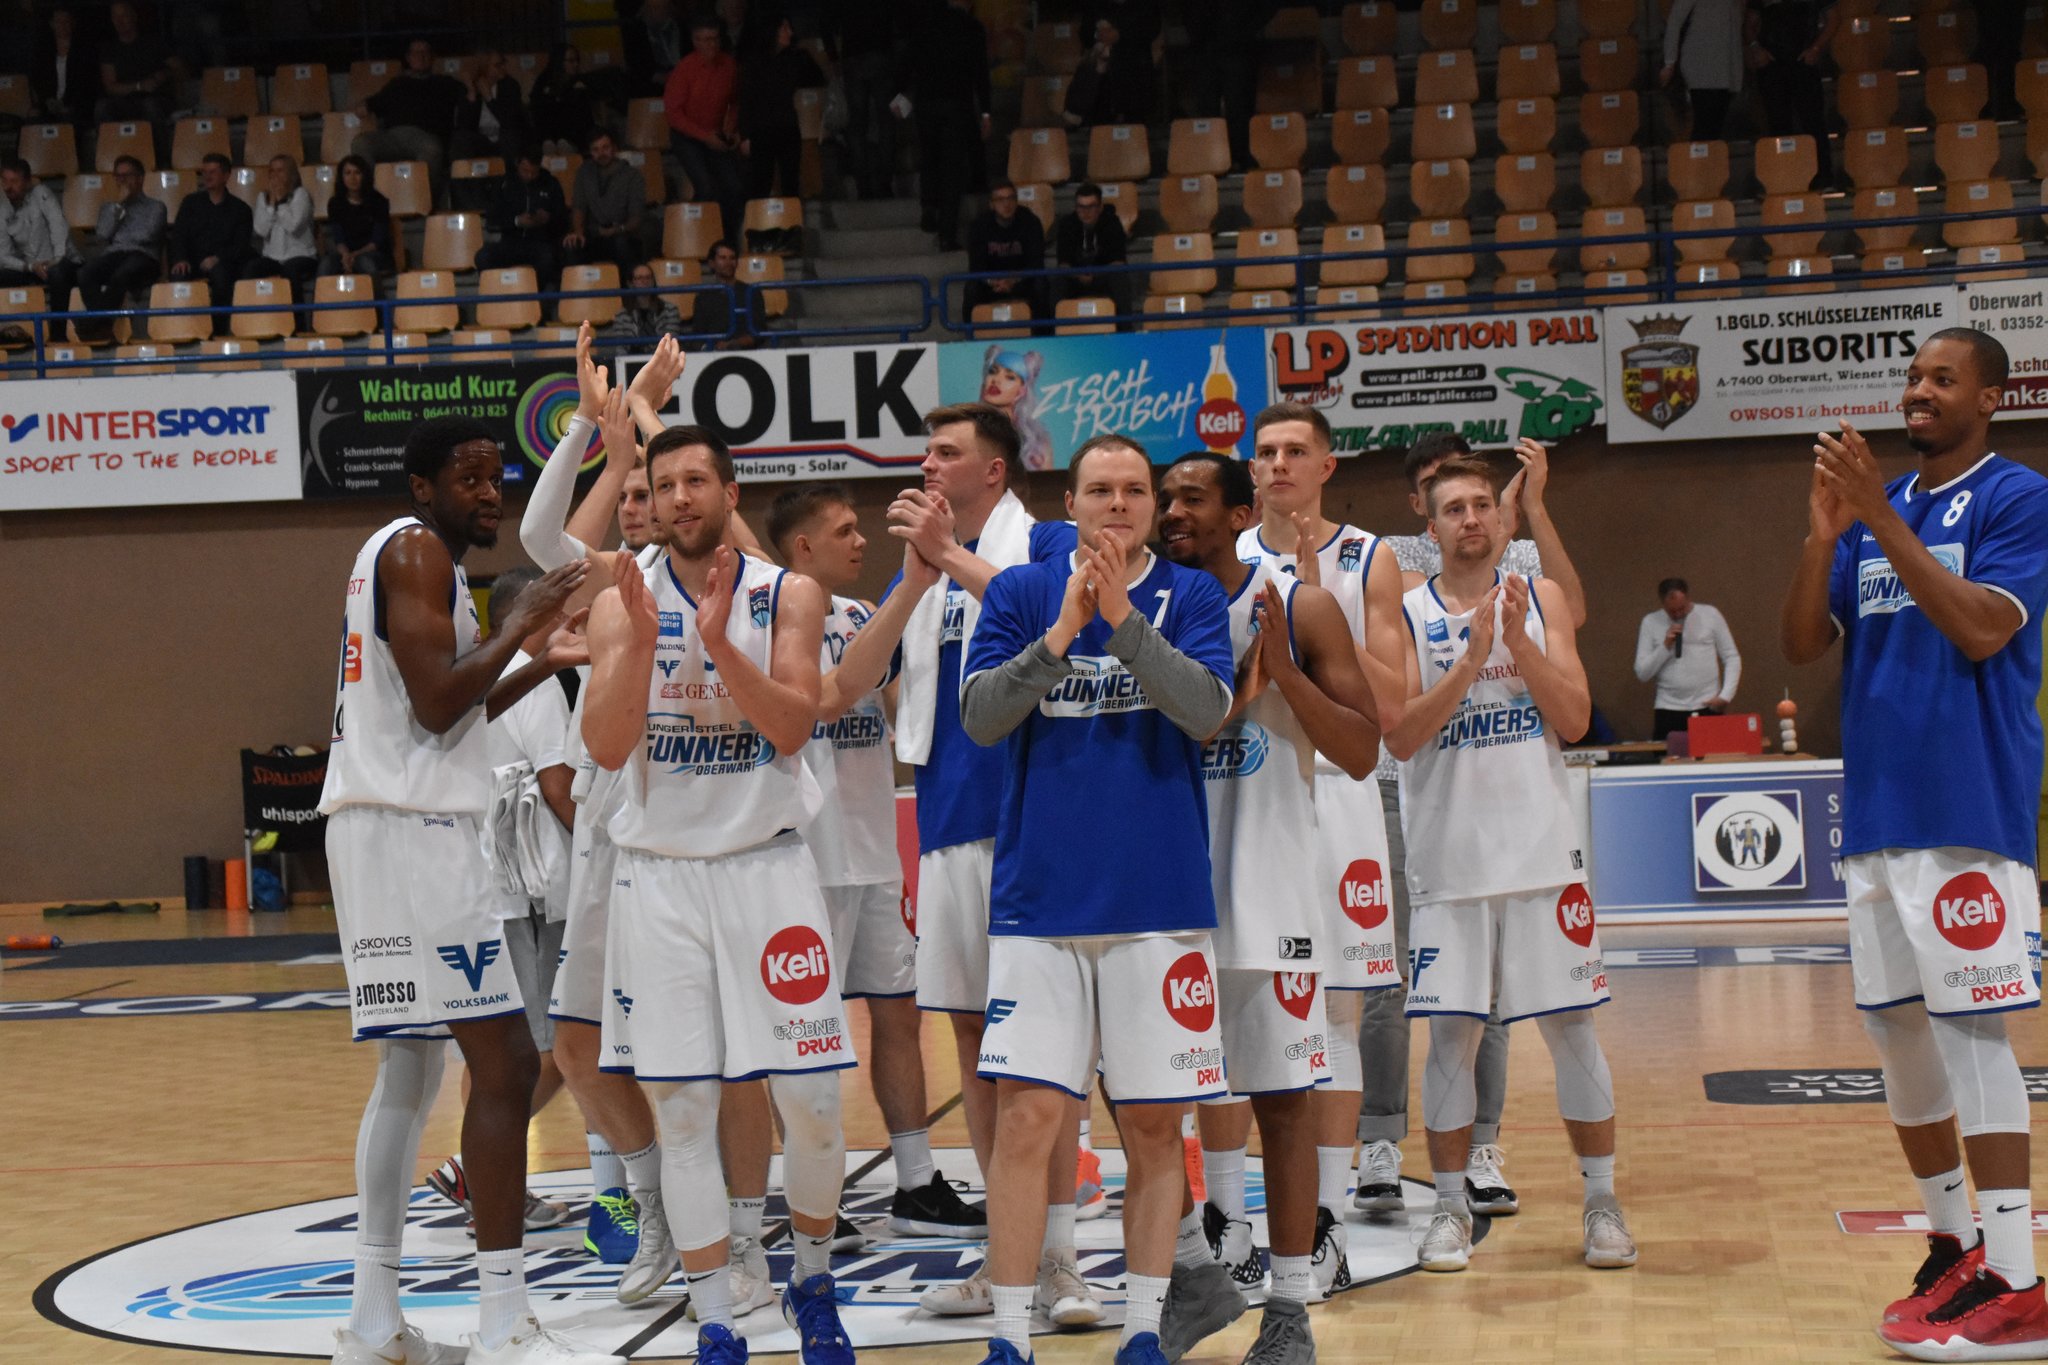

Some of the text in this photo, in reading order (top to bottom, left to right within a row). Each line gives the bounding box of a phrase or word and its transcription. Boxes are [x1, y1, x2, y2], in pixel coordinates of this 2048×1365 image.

[1969, 291, 2043, 311] Oberwart
[1778, 302, 1943, 327] SCHLÜSSELZENTRALE
[1357, 315, 1598, 355] SPEDITION PALL
[1743, 330, 1917, 367] SUBORITS
[1368, 366, 1480, 383] www.pall-sped.at
[1768, 371, 1833, 385] Oberwart,
[1837, 369, 1884, 381] Wiener
[360, 375, 518, 404] Waltraud Kurz
[625, 347, 928, 447] OLK
[1031, 359, 1153, 419] ZISCH
[1357, 389, 1494, 406] www.pall-logistics.com
[46, 404, 271, 443] INTERSPORT
[364, 408, 413, 423] Rechnitz
[1071, 382, 1199, 444] FRISCH
[1199, 411, 1241, 435] Keli
[1462, 419, 1509, 444] PALL
[3, 448, 279, 475] SPORT TO THE PEOPLE
[343, 446, 406, 458] Schmerztherapi
[734, 459, 848, 478] Heizung Solar
[1942, 489, 1973, 528] 8
[658, 613, 681, 621] ezirks
[1153, 587, 1172, 629] 7
[656, 643, 686, 653] PALDING
[647, 723, 735, 733] UNGER STEEL
[1474, 732, 1529, 749] OBERWART
[252, 765, 326, 786] SPALDIN
[695, 760, 756, 776] OBERWART
[262, 807, 322, 825] uhlspor
[1939, 892, 1999, 929] Keli
[766, 944, 826, 985] Keli
[1944, 963, 2023, 988] GRÖBNER
[443, 992, 510, 1009] VOLKSBANK
[1971, 980, 2027, 1004] DRUCK
[773, 1017, 841, 1041] GRÖBNER
[1170, 1046, 1220, 1071] GRÖBNE
